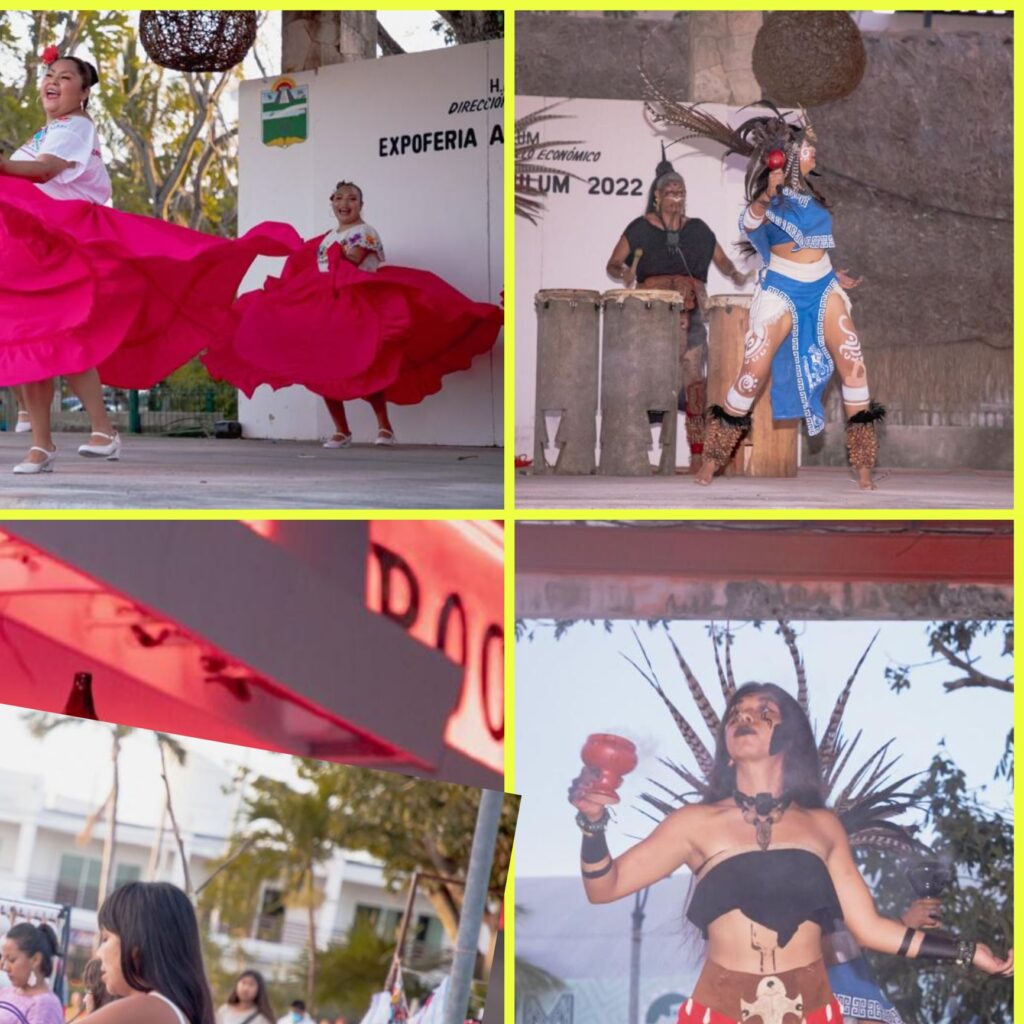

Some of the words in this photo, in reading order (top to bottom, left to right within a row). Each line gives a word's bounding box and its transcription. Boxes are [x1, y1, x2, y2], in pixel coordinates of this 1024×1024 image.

[379, 127, 478, 157] EXPOFERIA
[536, 146, 601, 162] ECONÓMICO
[588, 176, 643, 196] 2022
